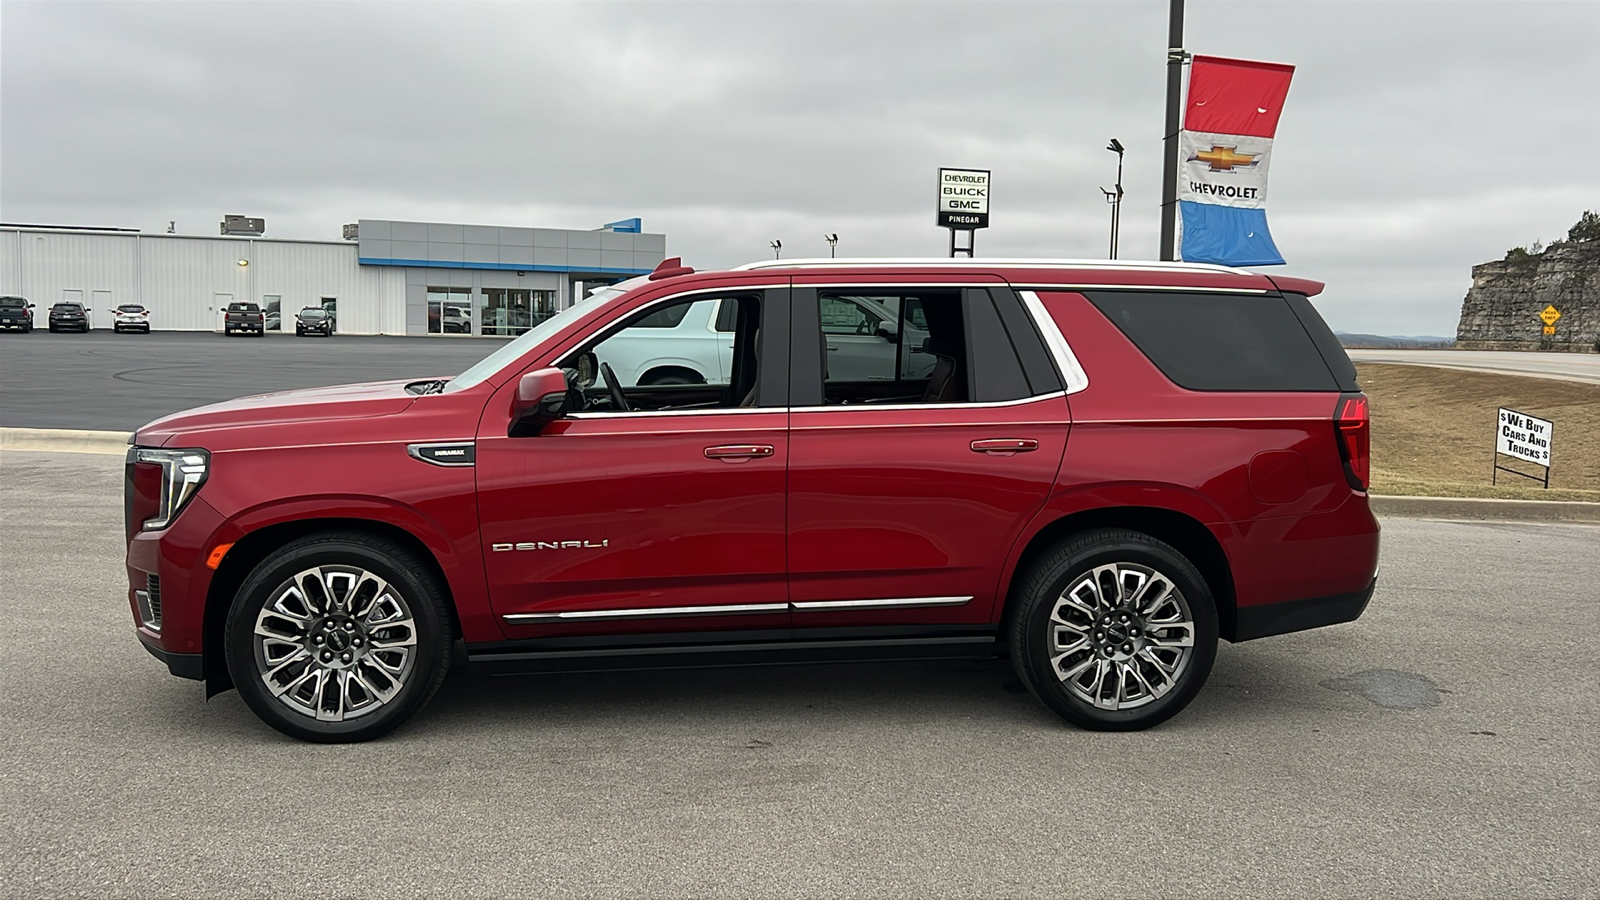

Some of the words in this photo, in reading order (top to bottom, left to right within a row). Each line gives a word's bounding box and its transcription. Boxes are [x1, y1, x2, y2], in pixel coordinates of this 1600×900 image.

[944, 174, 986, 184] CHEVROLET
[943, 187, 986, 197] BUICK
[949, 200, 980, 209] GMC
[949, 215, 979, 224] PINEGAR
[1507, 413, 1524, 429] WE
[1526, 418, 1544, 434] BUY
[1502, 425, 1526, 442] CARS
[1528, 432, 1547, 448] AND
[1507, 439, 1541, 460] TRUCKS
[492, 539, 608, 552] DENALI
